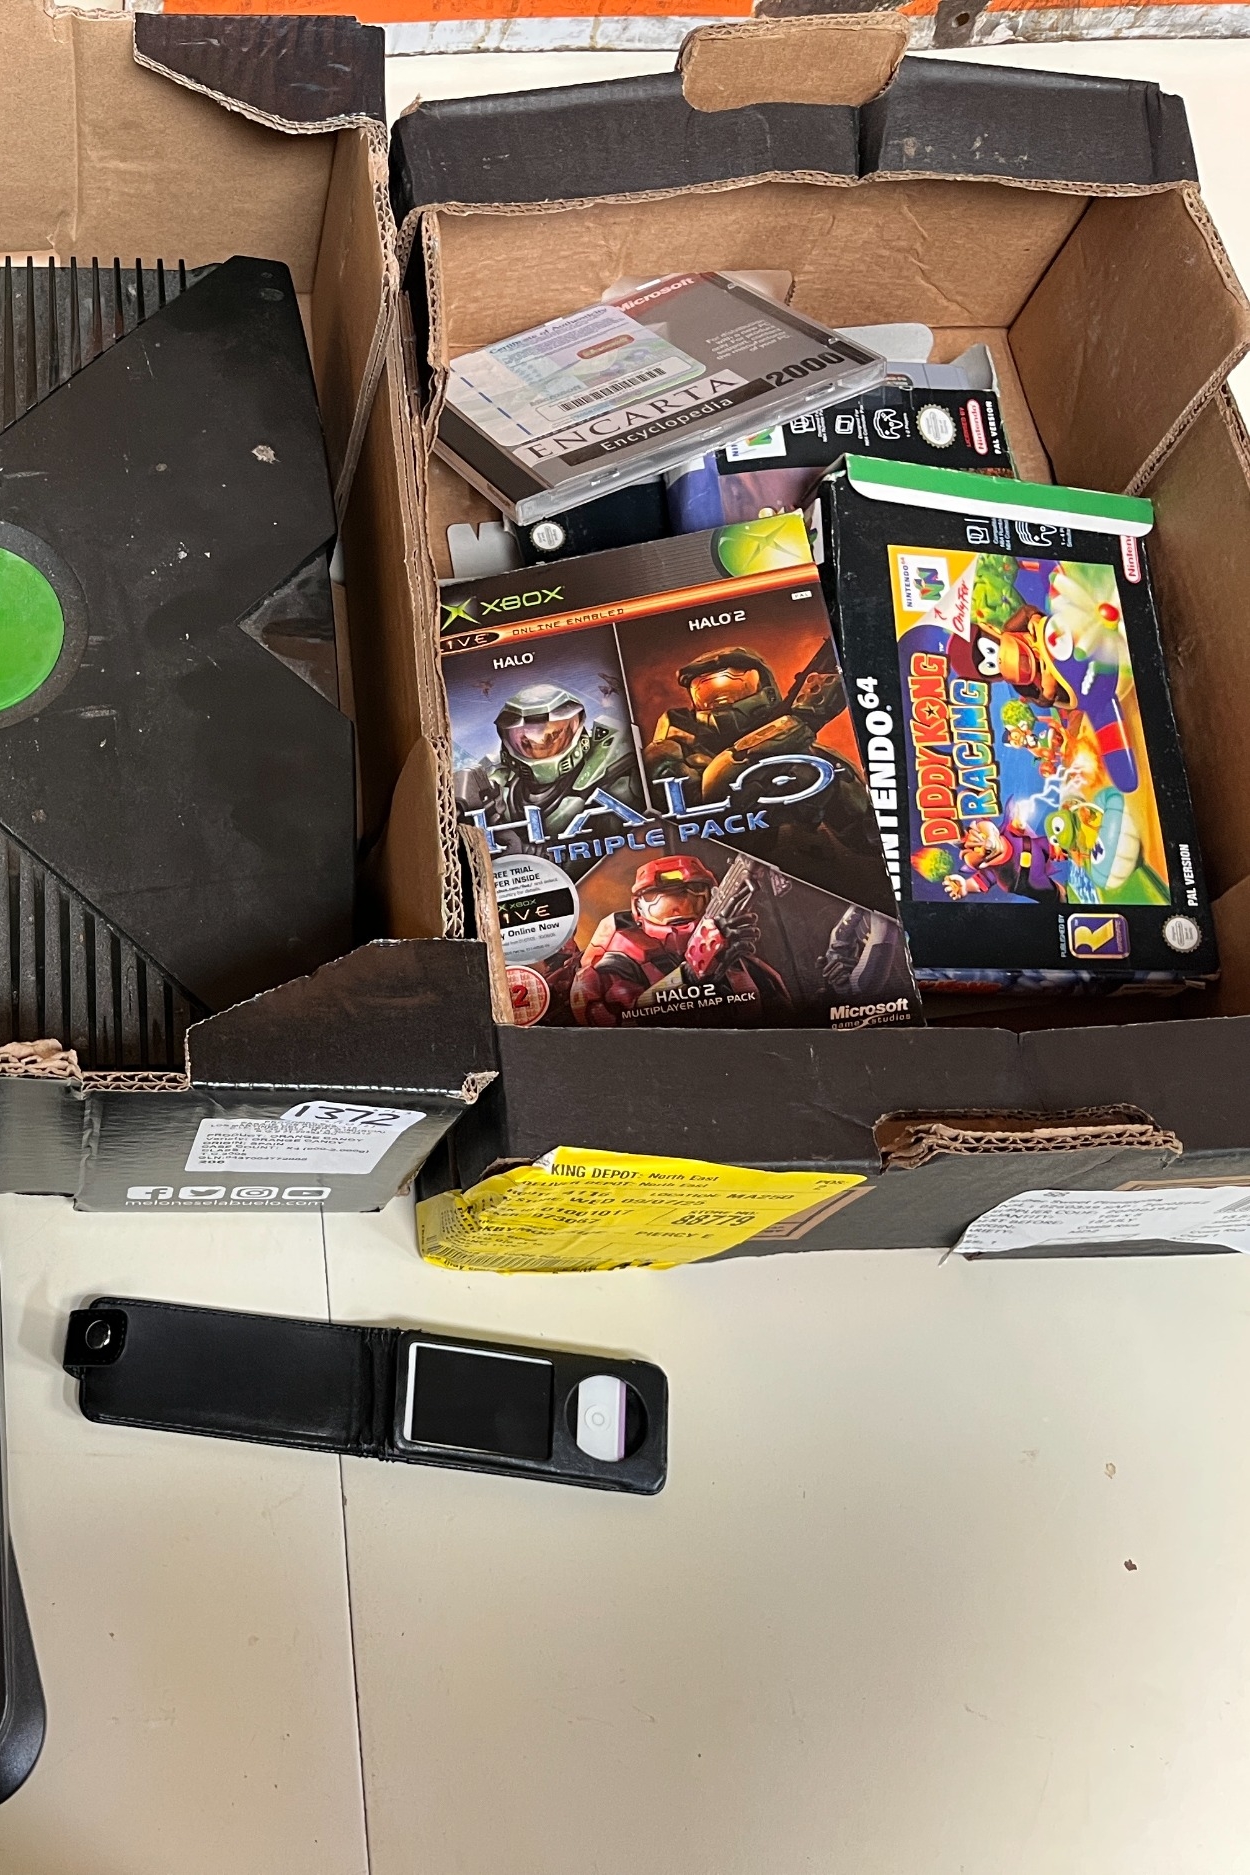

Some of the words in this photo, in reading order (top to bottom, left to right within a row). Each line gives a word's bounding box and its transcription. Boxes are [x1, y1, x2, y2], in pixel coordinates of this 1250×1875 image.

[616, 276, 696, 313] Microsoft
[766, 351, 845, 387] 2000
[525, 377, 738, 459] ENCARTA
[600, 398, 734, 452] Encyclopedia
[970, 404, 985, 451] Nintendo
[985, 400, 998, 437] VERSION
[992, 438, 1002, 455] PAL
[1121, 536, 1137, 577] Ninten
[480, 585, 565, 616] XBOX
[903, 564, 913, 608] NINTENDO
[957, 579, 969, 604] For
[512, 620, 561, 637] ONLINE
[566, 607, 625, 626] ENABLED
[688, 611, 732, 632] HALO
[733, 609, 747, 624] 2
[953, 602, 968, 632] Only
[493, 652, 534, 670] HALO
[856, 676, 880, 709] 64
[907, 652, 952, 748] KONG
[949, 678, 1000, 820] RACING
[465, 753, 843, 855] HALO
[916, 743, 962, 847] DIDDY
[547, 822, 668, 866] TRIPLE
[679, 809, 770, 844] PACK
[493, 869, 508, 880] REE
[509, 865, 534, 877] TRIAL
[1178, 843, 1195, 886] VERSION
[495, 878, 510, 889] FER
[512, 873, 540, 885] INSIDE
[509, 898, 537, 910] XBOX
[1186, 887, 1199, 907] PAL
[503, 904, 551, 924] IVE
[507, 927, 537, 938] Online
[539, 922, 560, 933] Now
[1058, 923, 1067, 958] PUBLISHED
[511, 984, 531, 1008] 2
[621, 1001, 695, 1020] MULTIPLAYER
[697, 996, 724, 1009] MAP
[726, 990, 757, 1003] PACK
[655, 985, 701, 1004] HALO
[704, 983, 716, 997] 2
[830, 997, 909, 1021] Microsoft
[870, 1012, 912, 1025] studios
[294, 1105, 401, 1126] 1372
[551, 1163, 586, 1178] KING
[591, 1167, 643, 1180] DEPOT:
[649, 1172, 686, 1181] North
[689, 1174, 720, 1182] East
[125, 1199, 325, 1207] meloneselabuelo.com
[569, 1197, 616, 1205] WED
[671, 1214, 756, 1227] 88779
